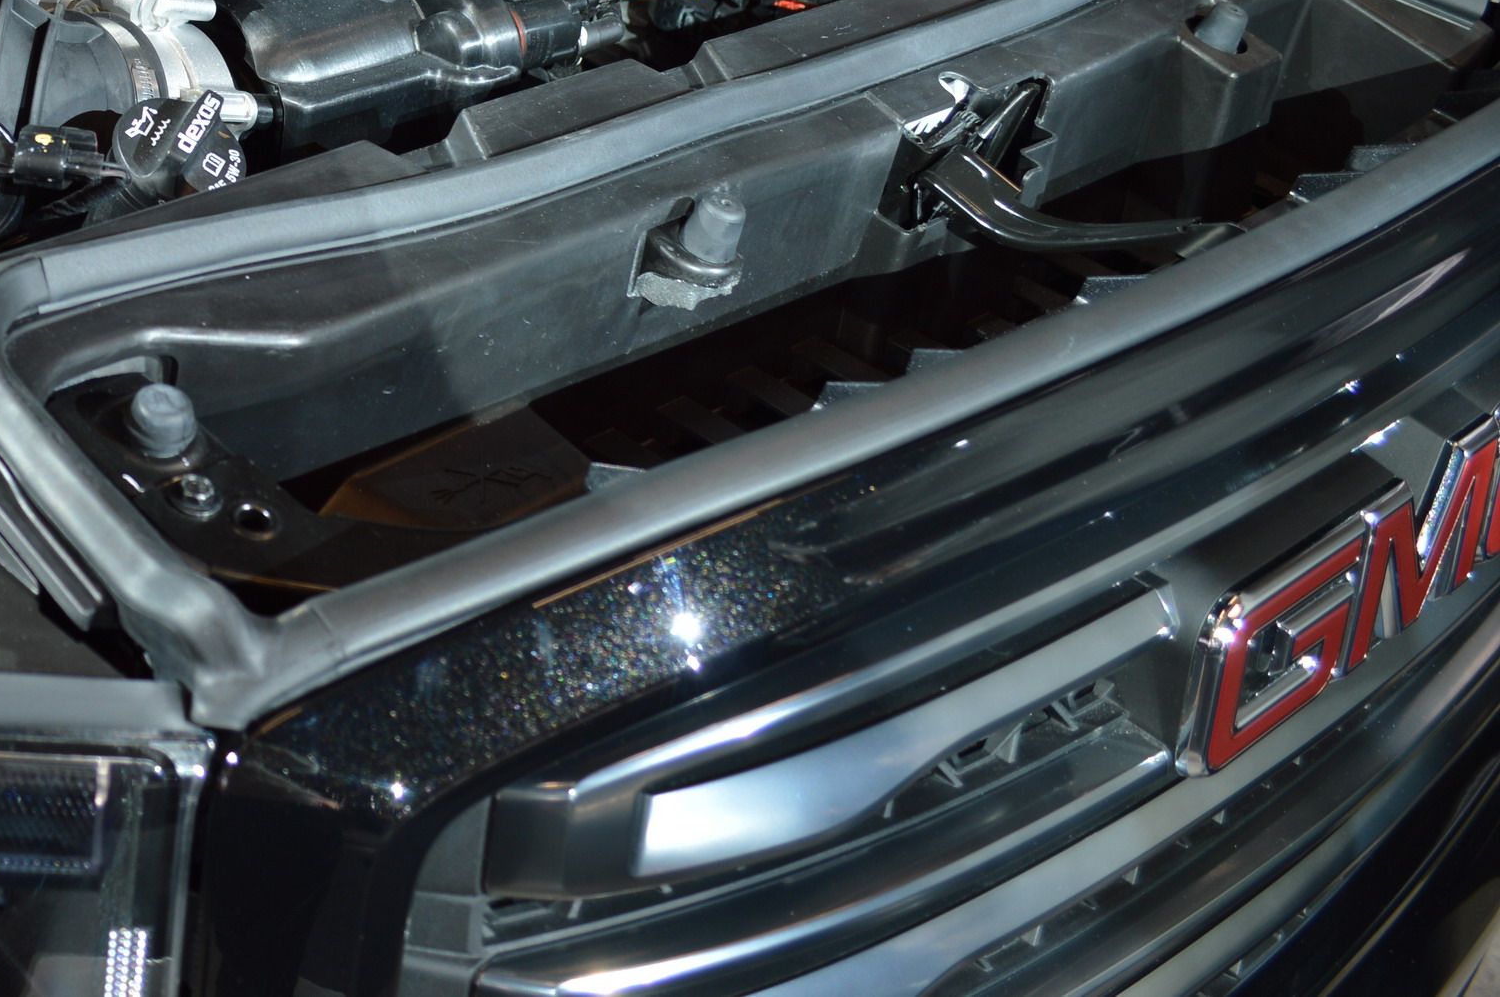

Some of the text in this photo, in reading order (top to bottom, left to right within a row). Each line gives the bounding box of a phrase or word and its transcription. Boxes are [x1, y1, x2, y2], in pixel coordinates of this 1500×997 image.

[178, 93, 220, 153] dexos
[225, 149, 241, 183] 5W-30
[1177, 408, 1500, 775] GM
